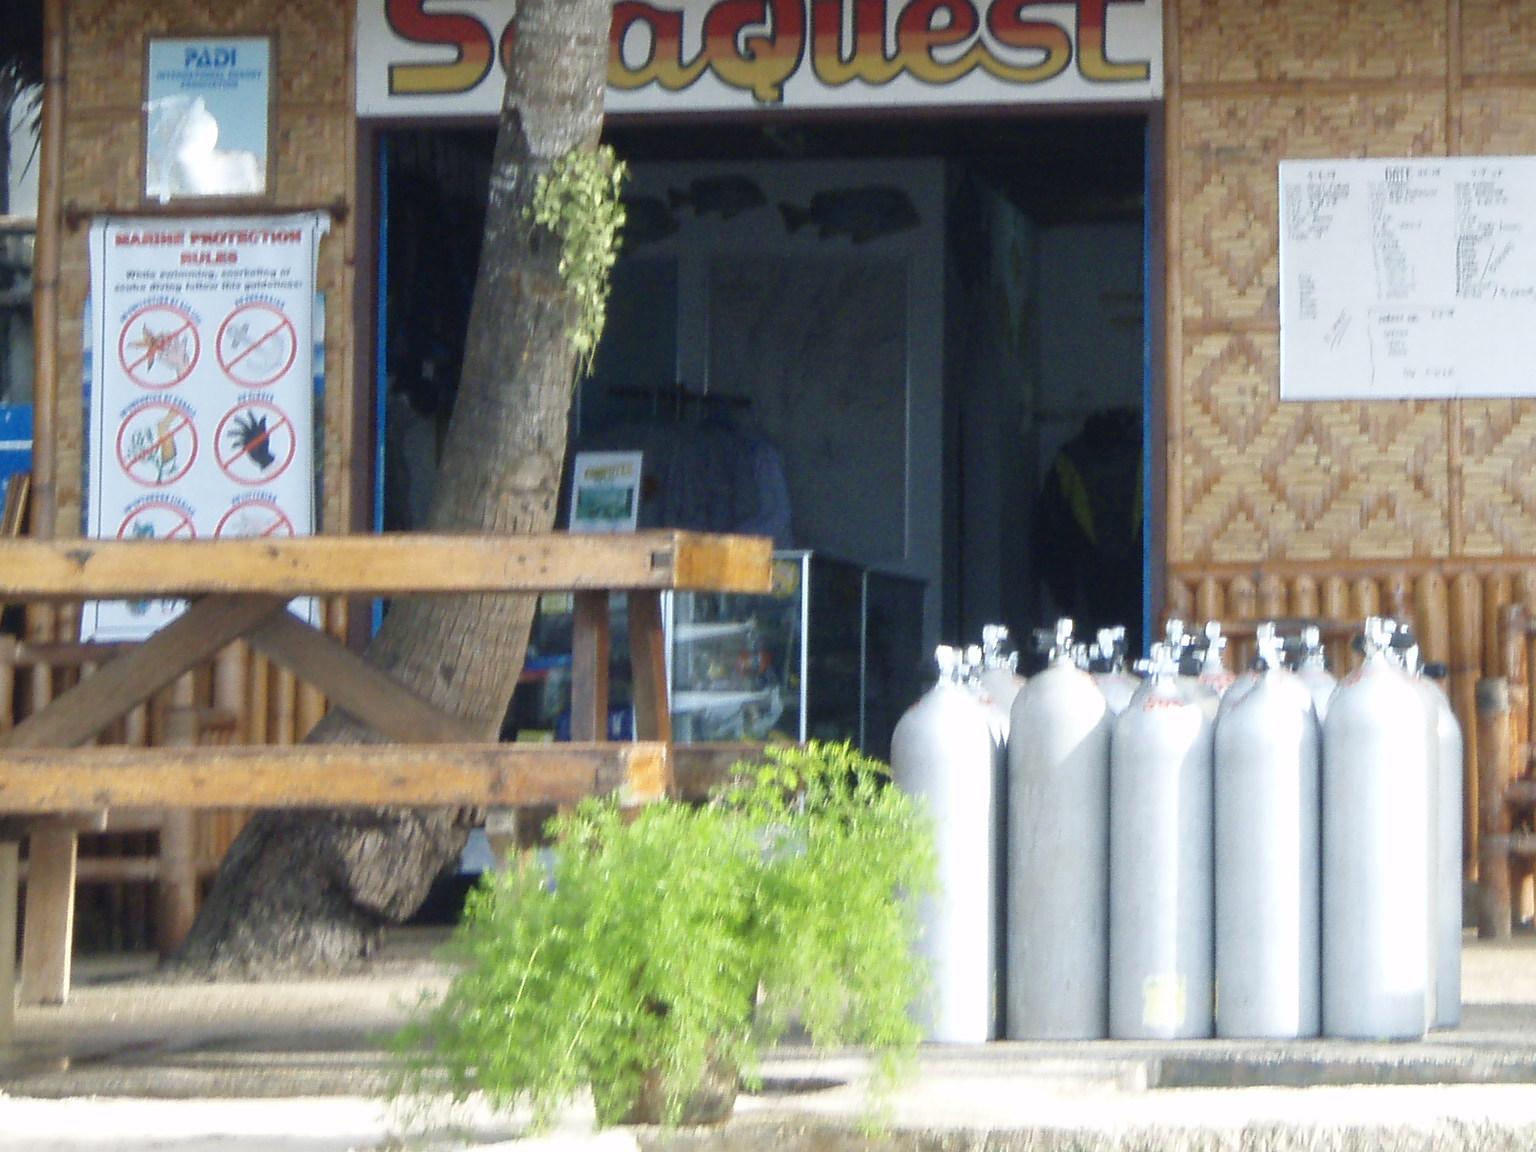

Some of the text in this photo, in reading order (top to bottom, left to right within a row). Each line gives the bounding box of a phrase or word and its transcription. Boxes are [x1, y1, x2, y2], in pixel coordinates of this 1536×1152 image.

[184, 46, 238, 67] PADI
[115, 229, 302, 247] MARINE PROTECTION
[180, 251, 238, 266] RULES
